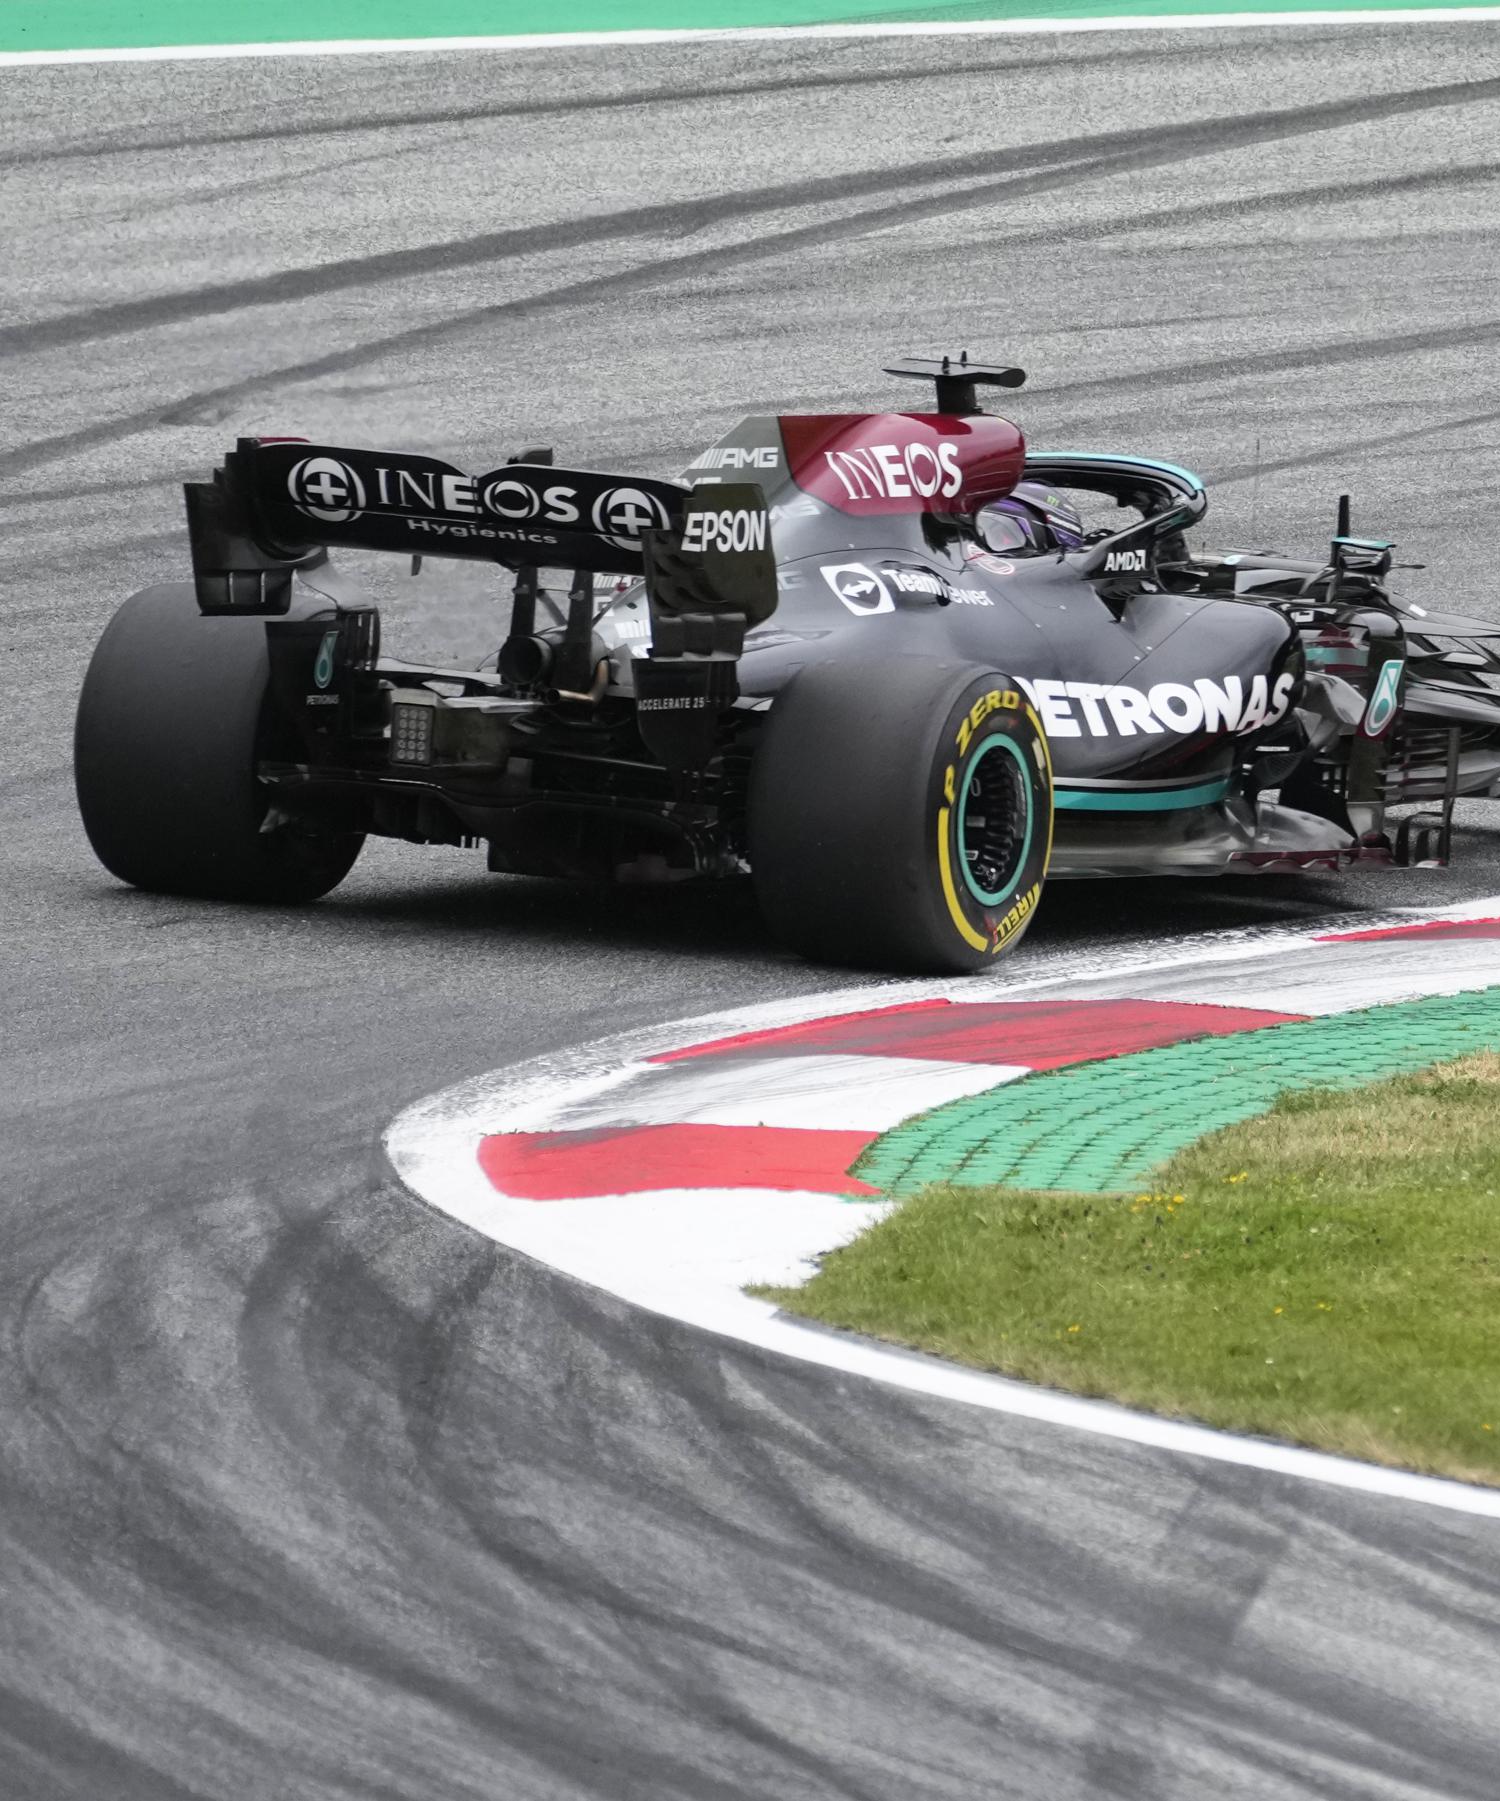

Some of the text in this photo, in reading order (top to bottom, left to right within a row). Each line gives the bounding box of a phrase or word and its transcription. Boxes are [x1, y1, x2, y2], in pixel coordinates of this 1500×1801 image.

[375, 468, 580, 523] INEOS
[824, 443, 963, 500] INEOS
[407, 519, 558, 544] Hygienics
[681, 510, 767, 552] EPSON
[955, 690, 1020, 758] ZERO
